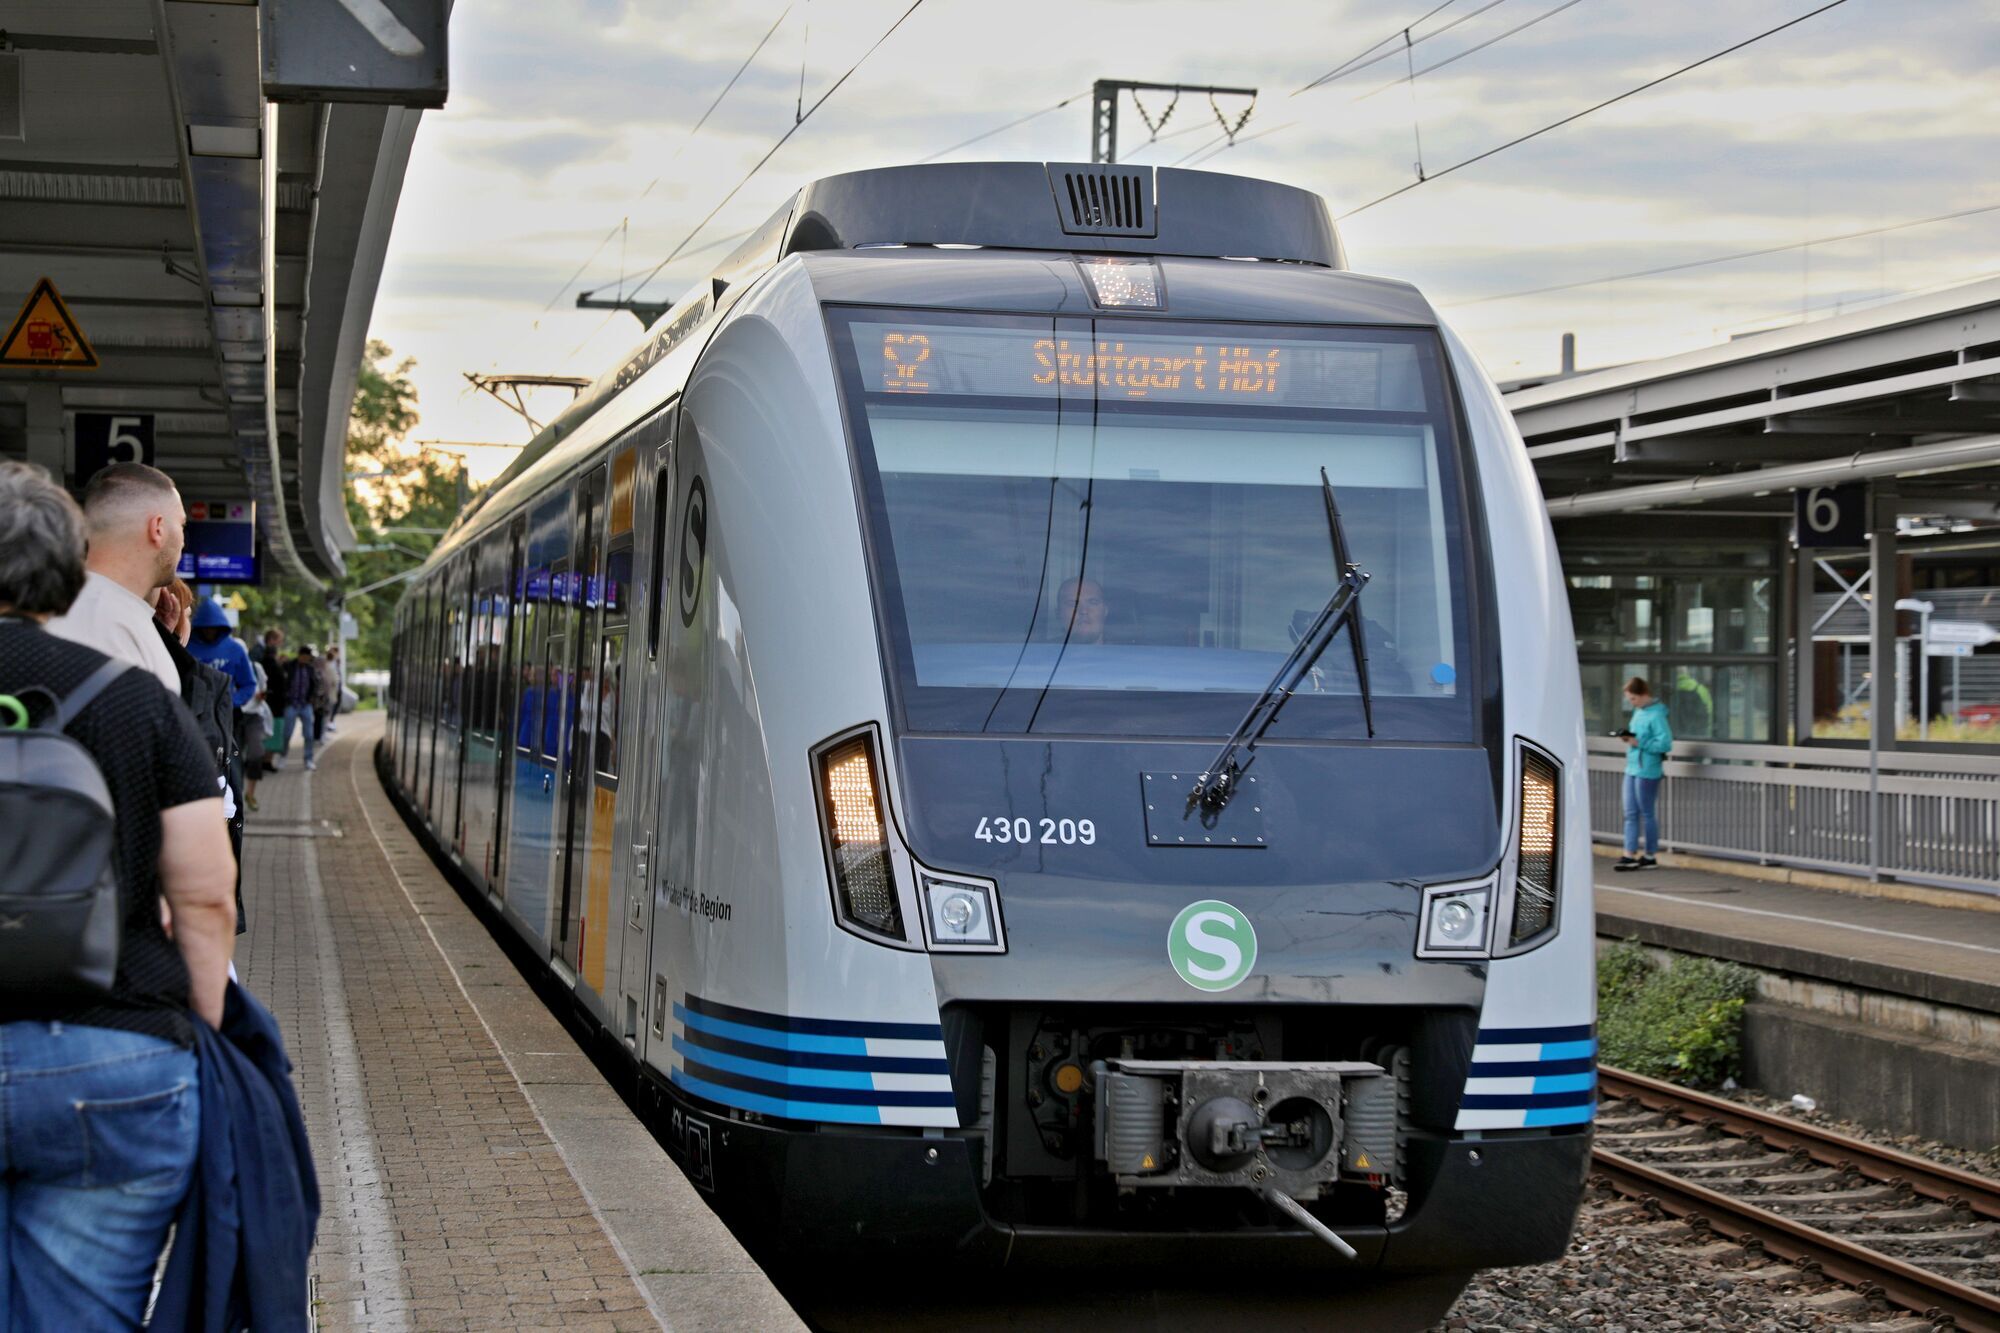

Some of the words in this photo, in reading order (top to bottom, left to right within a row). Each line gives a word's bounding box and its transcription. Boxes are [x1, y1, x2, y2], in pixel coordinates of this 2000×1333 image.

[1032, 339, 1208, 396] Stuttgart
[1218, 346, 1281, 392] Hbf
[107, 416, 144, 466] 5
[1806, 485, 1839, 533] 6
[681, 488, 704, 615] S
[974, 816, 1032, 844] 430
[1039, 818, 1096, 845] 209
[700, 892, 732, 922] Region
[1184, 910, 1242, 981] S
